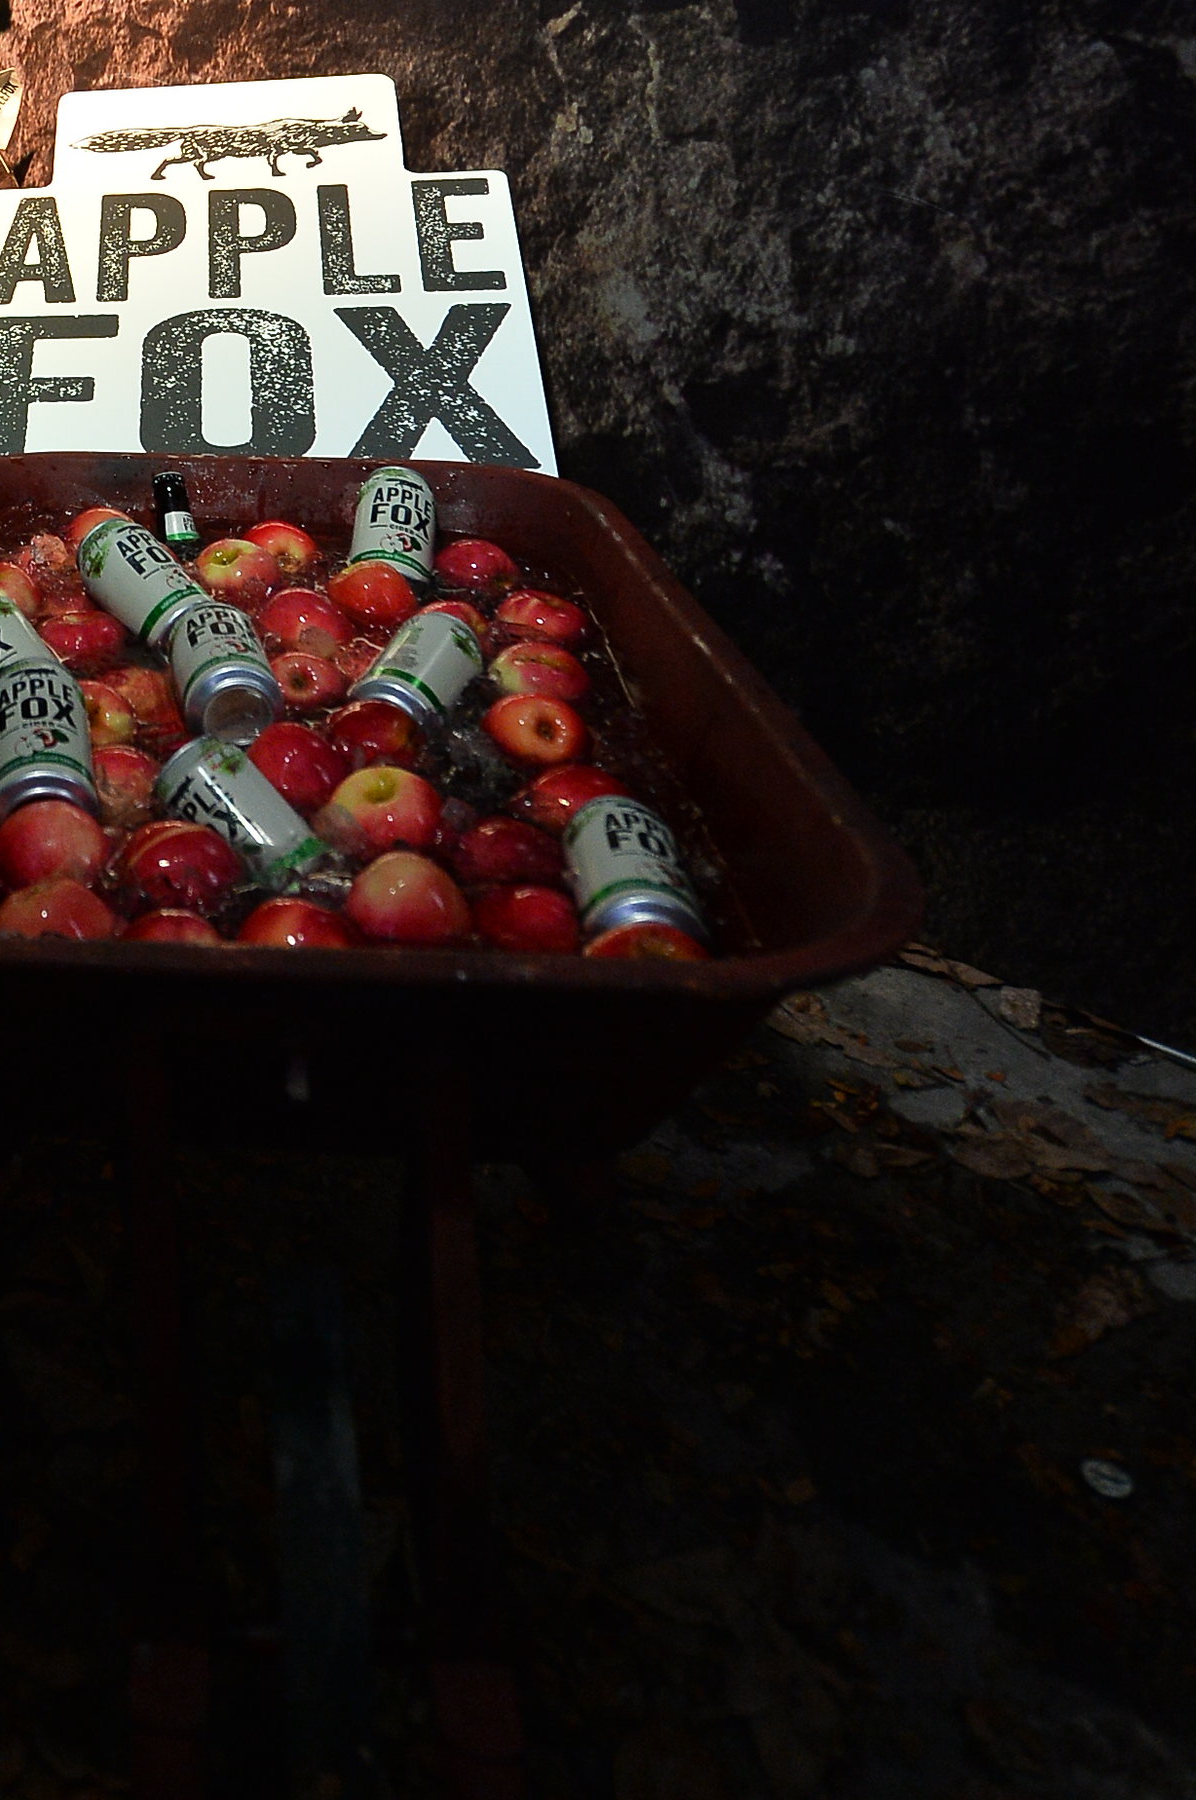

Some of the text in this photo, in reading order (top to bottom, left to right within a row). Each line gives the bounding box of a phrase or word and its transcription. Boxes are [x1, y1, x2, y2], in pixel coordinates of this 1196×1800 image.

[372, 487, 432, 520] APPLE
[370, 503, 430, 540] FOX
[126, 546, 173, 575] FO
[606, 830, 669, 858] FO
